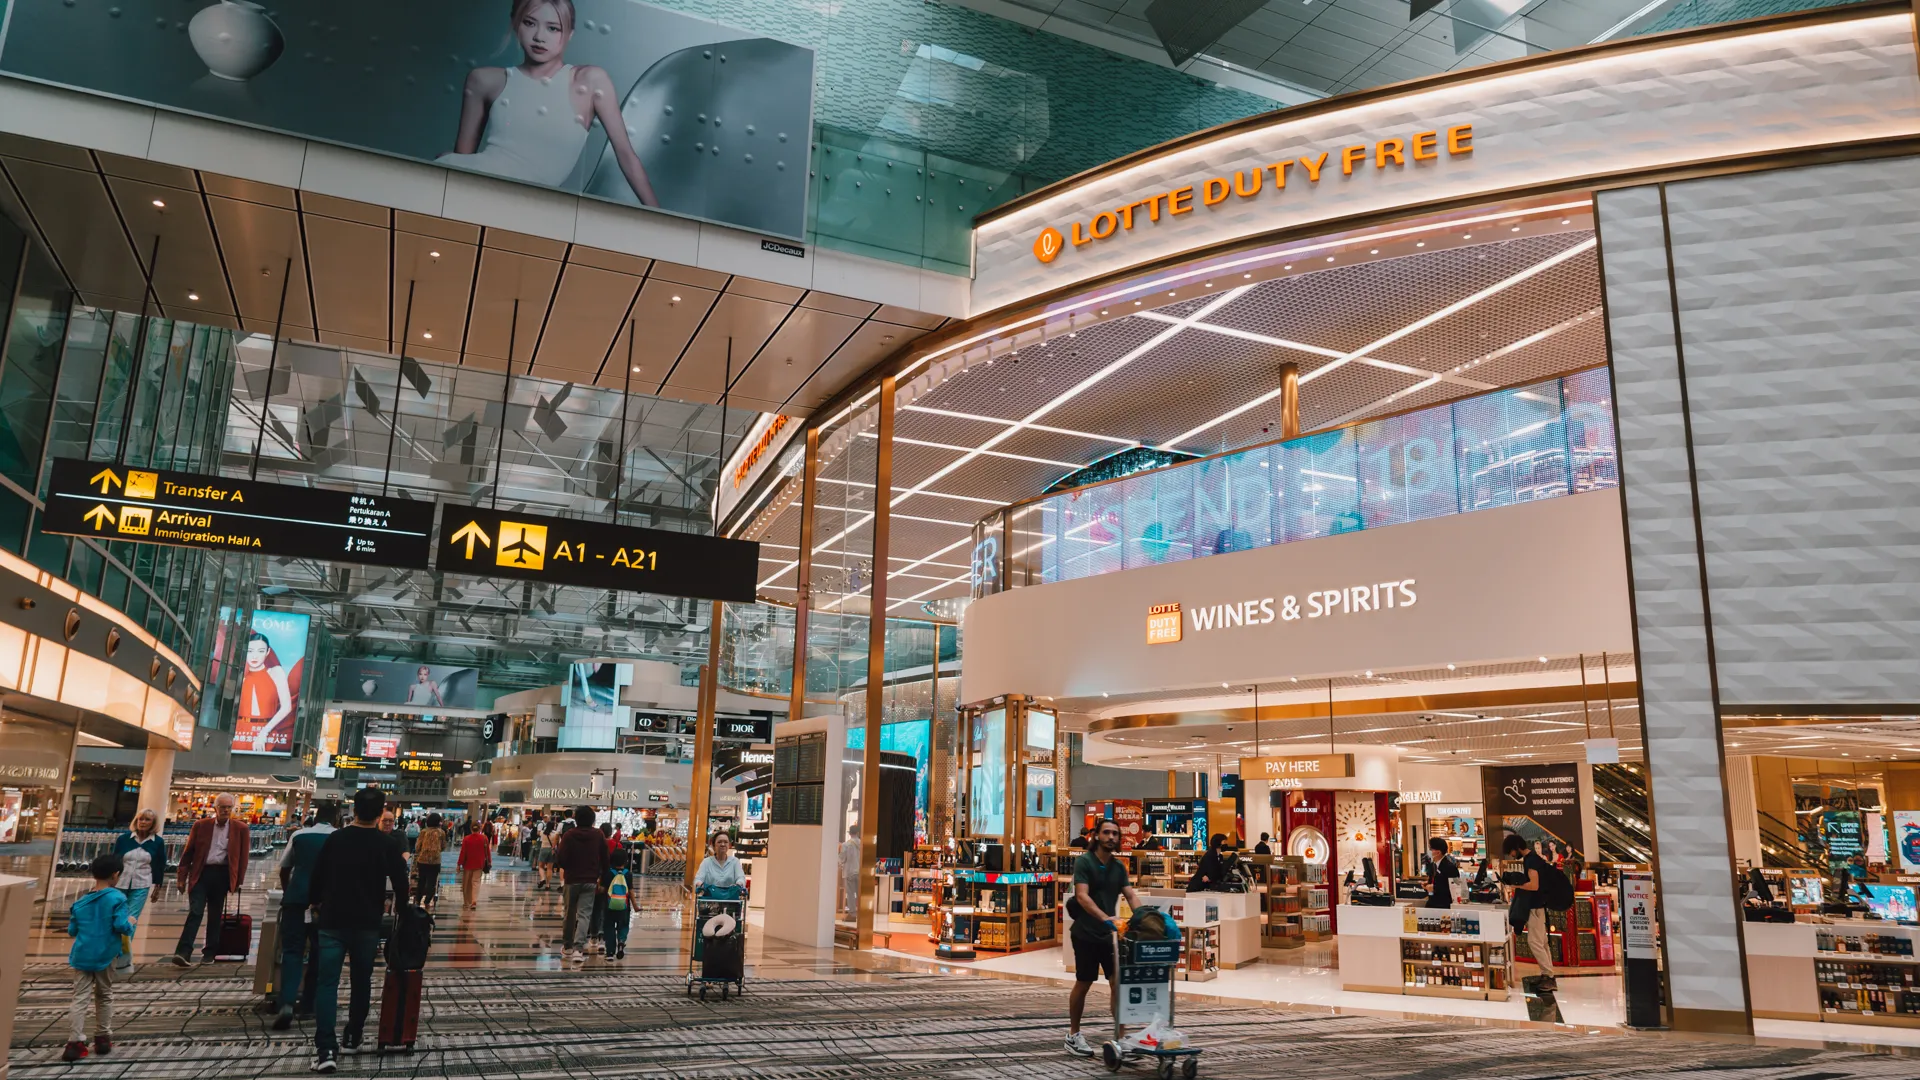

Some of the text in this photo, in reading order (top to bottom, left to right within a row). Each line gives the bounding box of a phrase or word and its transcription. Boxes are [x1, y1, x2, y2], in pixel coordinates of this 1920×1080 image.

[1072, 124, 1474, 246] LOTTE DUTY FREE
[763, 242, 803, 256] JCDecaux
[163, 481, 244, 503] Transfer A
[349, 506, 385, 517] Pertukaran
[157, 510, 212, 528] Arrival
[154, 527, 262, 548] Immigration Hall A
[357, 538, 366, 546] Up
[553, 540, 586, 564] A1
[611, 547, 657, 571] A21
[1148, 602, 1180, 615] LOTTE
[1190, 579, 1417, 631] WINES & SPIRITS
[1150, 616, 1177, 629] DUTY
[1150, 627, 1177, 640] FREE
[730, 723, 755, 733] DIOR
[1265, 760, 1320, 774] PAY HERE
[568, 788, 578, 799] &
[1141, 945, 1171, 954] Trip.com
